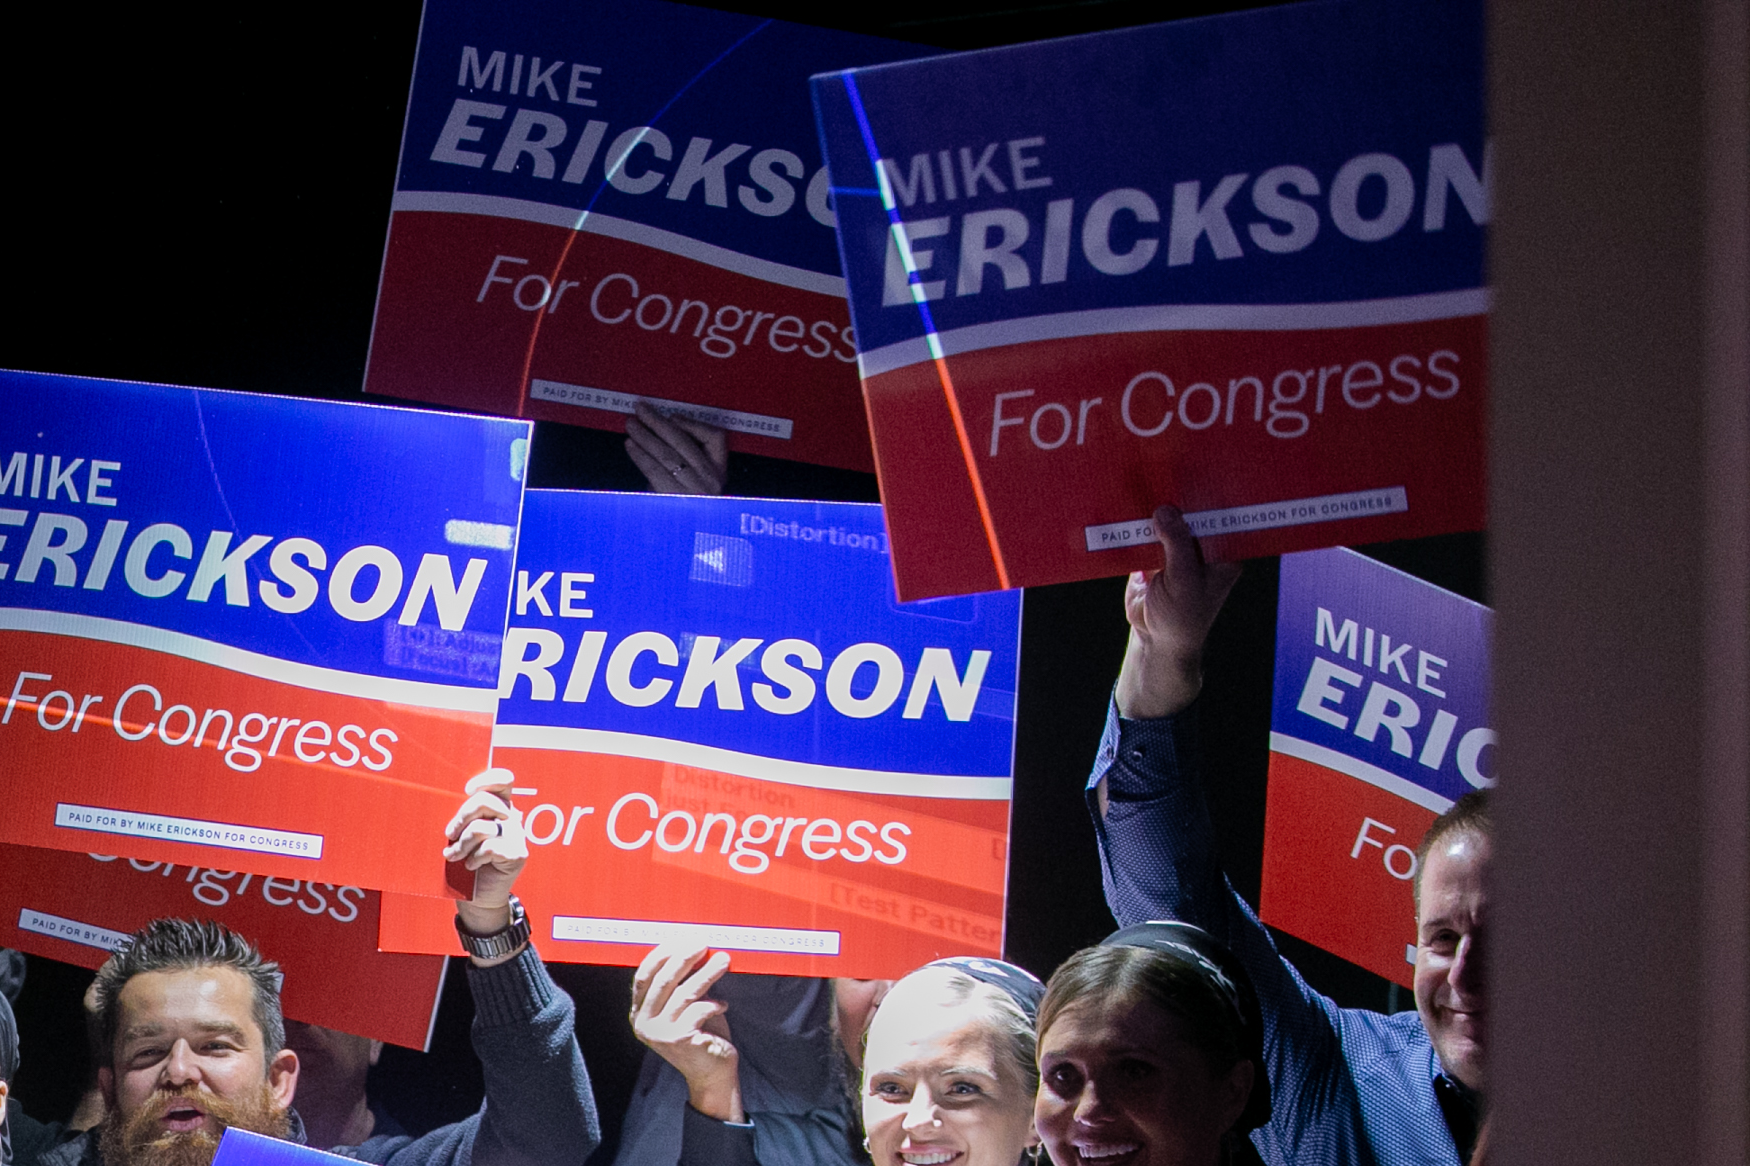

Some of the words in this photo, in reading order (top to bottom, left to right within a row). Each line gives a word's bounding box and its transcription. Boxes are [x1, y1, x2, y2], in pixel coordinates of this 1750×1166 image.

[458, 46, 601, 106] MIKE
[875, 137, 1051, 210] MIKE
[881, 141, 1493, 309] ERICKSON
[477, 255, 579, 313] For
[590, 273, 859, 362] Congress
[543, 387, 567, 397] PAID
[571, 391, 591, 402] FOR
[595, 395, 609, 404] BY
[698, 411, 720, 422] FOR
[721, 415, 780, 433] CONGRESS
[990, 390, 1102, 456] For
[1121, 351, 1459, 438] Congress
[1102, 529, 1130, 543] PAID
[1136, 526, 1157, 537] FO
[1222, 510, 1287, 527] ERICKSON
[1291, 506, 1317, 518] FOR
[1321, 496, 1393, 514] CONGRESS
[514, 571, 595, 619] KE
[498, 627, 992, 723] RICKSON
[1316, 607, 1447, 698] MIKE
[2, 672, 103, 732] For
[113, 685, 398, 772] Congress
[1296, 656, 1499, 790] ERIC
[69, 812, 92, 824] PAID
[96, 816, 117, 827] FOR
[120, 819, 133, 829] BY
[137, 821, 163, 833] MIKE
[167, 825, 221, 840] ERICKSON
[225, 833, 245, 843] FOR
[250, 835, 309, 851] CONGRESS
[512, 788, 595, 846] or
[606, 793, 911, 874] Congress
[1350, 816, 1419, 881] Fo
[32, 918, 56, 930] PAID
[60, 925, 80, 937] FOR
[84, 931, 97, 940] BY
[101, 936, 119, 945] MIK
[910, 904, 1003, 944] Patter
